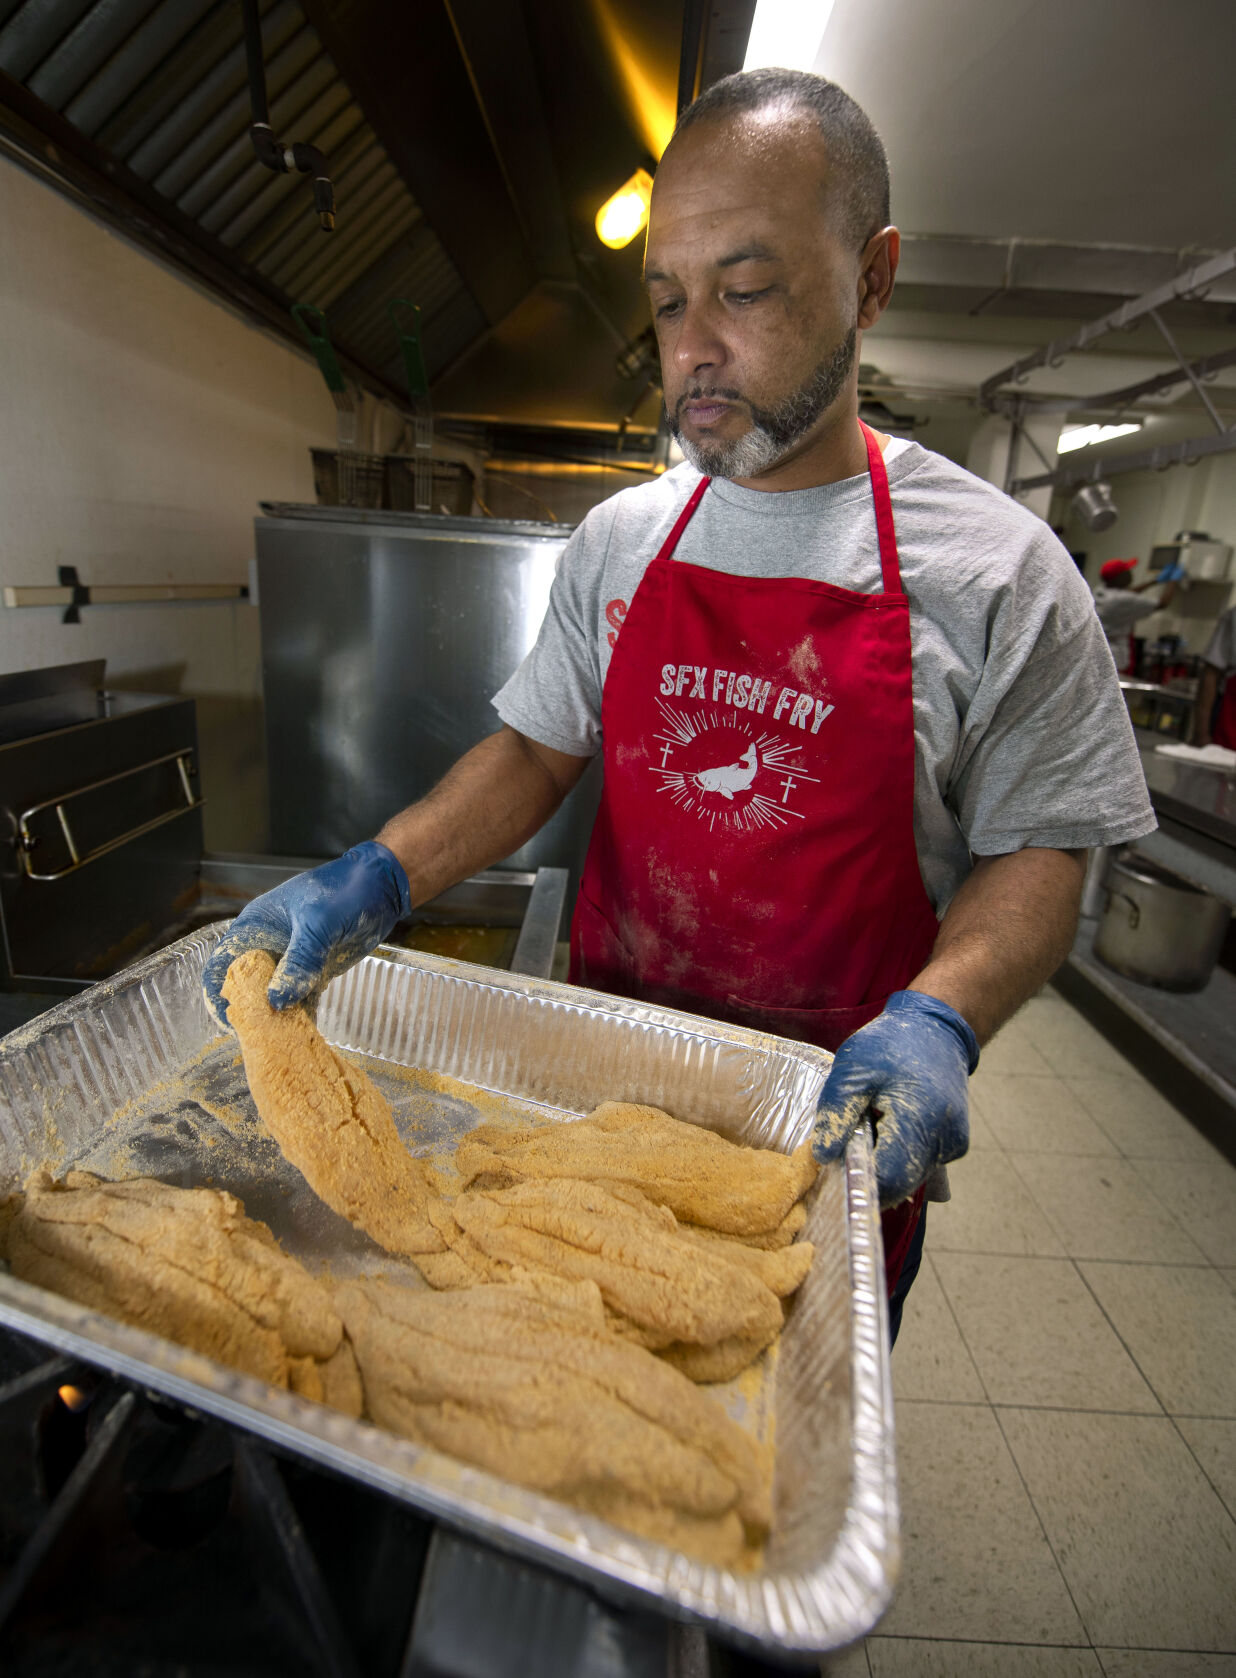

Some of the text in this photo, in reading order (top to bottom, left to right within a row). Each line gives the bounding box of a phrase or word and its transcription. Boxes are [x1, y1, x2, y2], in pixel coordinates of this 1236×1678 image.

[659, 663, 835, 734] SFX FISH FRY
